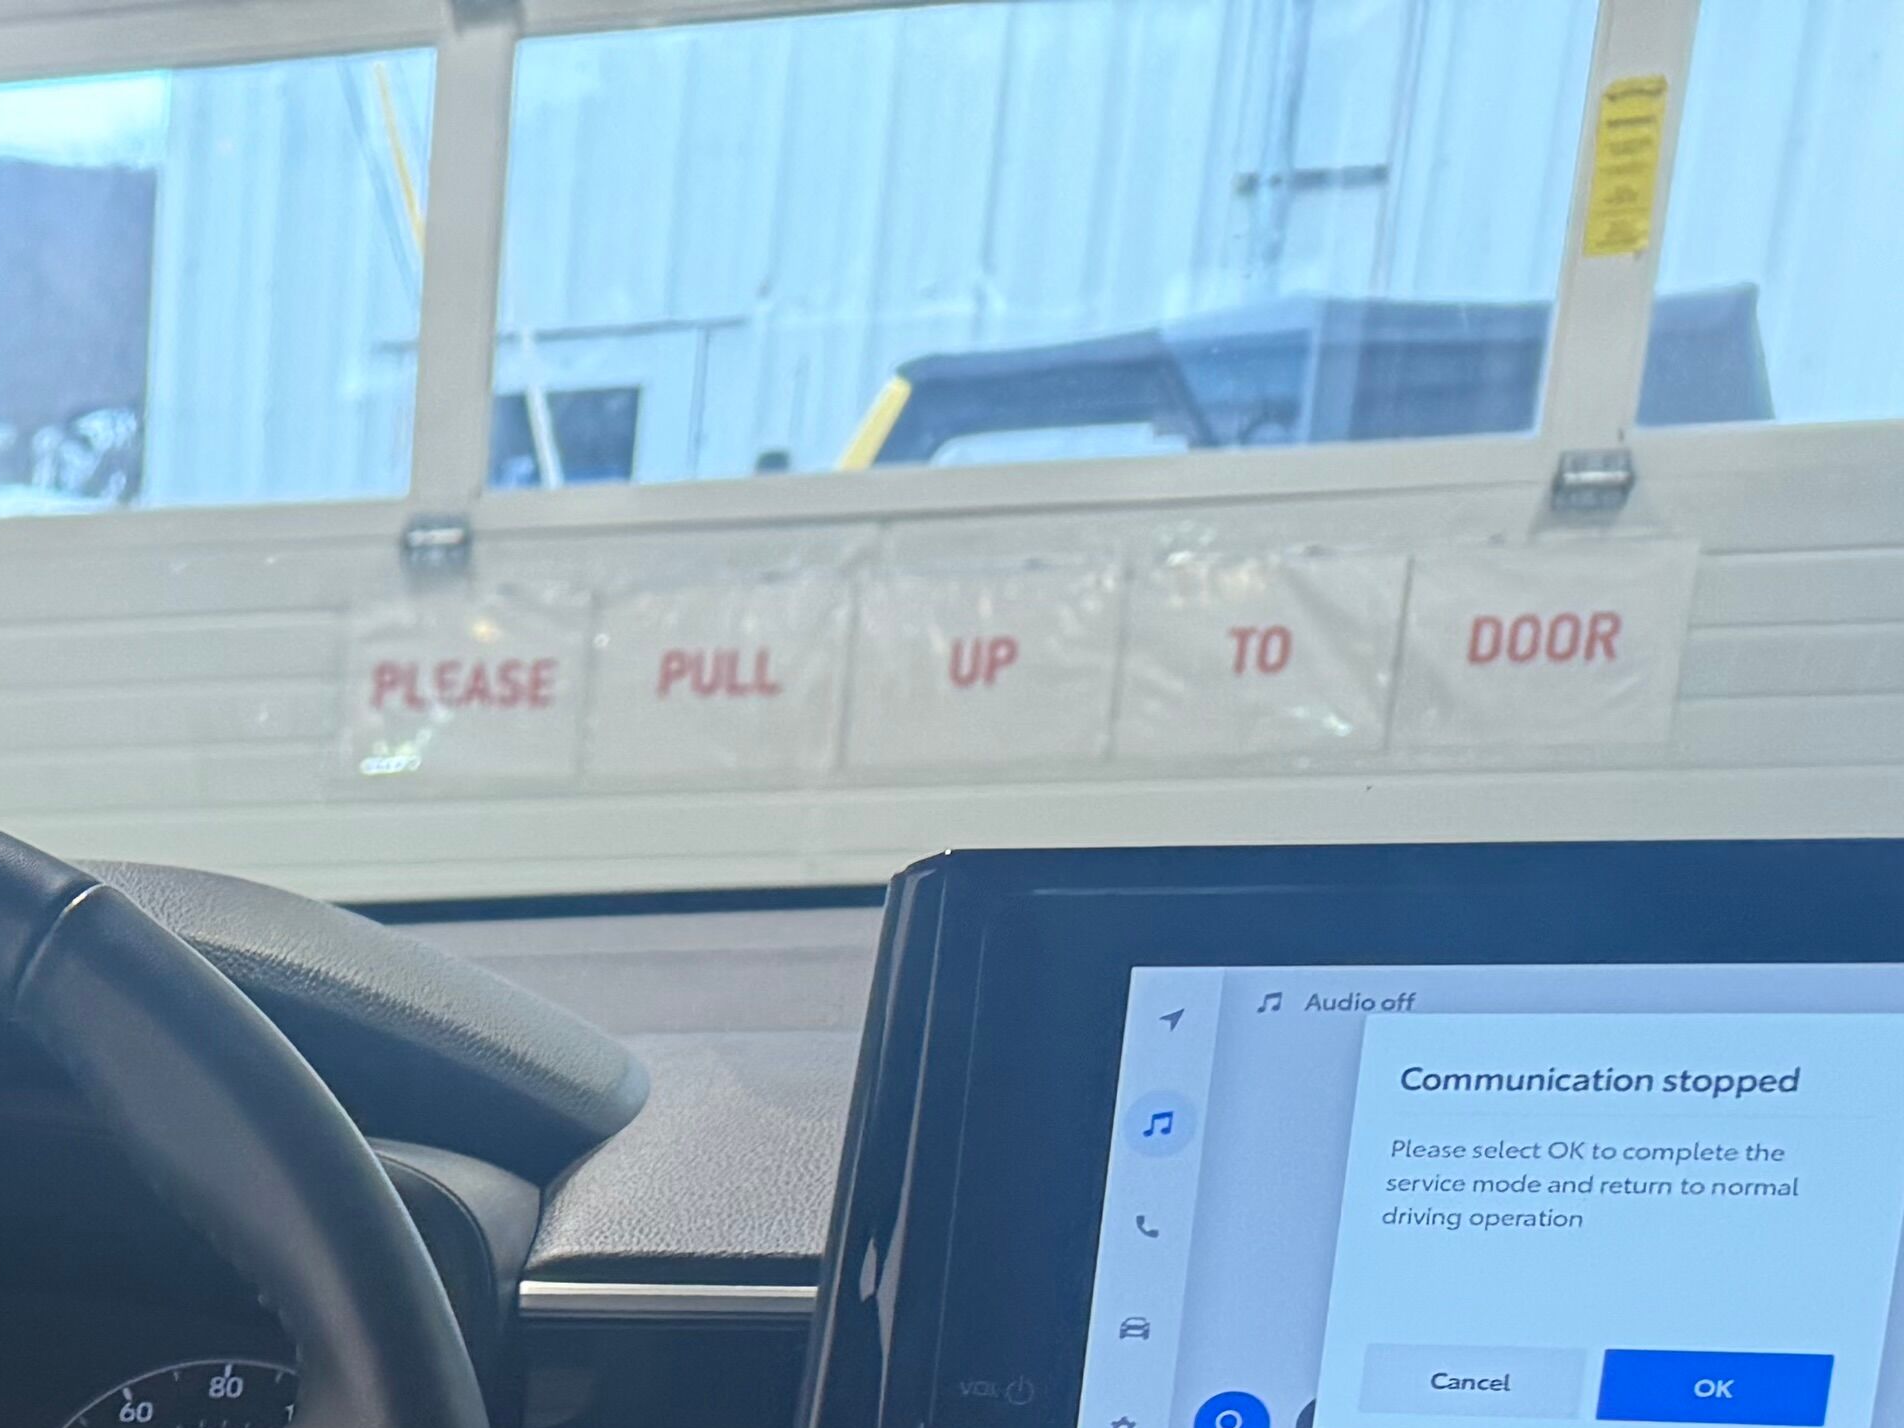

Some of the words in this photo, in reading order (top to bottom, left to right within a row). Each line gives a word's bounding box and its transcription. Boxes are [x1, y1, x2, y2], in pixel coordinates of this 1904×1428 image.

[370, 656, 558, 712] PLEASE
[656, 645, 780, 700] PULL
[948, 635, 1020, 690] UP
[1228, 624, 1293, 676] TO
[1465, 610, 1623, 667] DOOR
[1304, 992, 1375, 1013] Audio
[1381, 991, 1417, 1012] off
[1400, 1065, 1654, 1093] Communication
[1662, 1066, 1801, 1099] stopped
[1391, 1140, 1466, 1161] Please
[1472, 1140, 1541, 1162] select
[1547, 1141, 1585, 1161] OK
[1591, 1143, 1617, 1162] to
[1623, 1142, 1740, 1167] complete
[1745, 1143, 1785, 1163] the
[1386, 1173, 1466, 1193] service
[1472, 1174, 1542, 1194] mode
[1547, 1175, 1594, 1195] and
[1599, 1178, 1673, 1197] return
[1680, 1178, 1705, 1197] to
[1711, 1176, 1800, 1198] normal
[1382, 1207, 1463, 1231] driving
[1469, 1208, 1584, 1232] operation
[208, 1376, 243, 1399] 80
[1430, 1372, 1511, 1393] Cancel
[1693, 1379, 1734, 1399] OK
[119, 1402, 153, 1423] 60
